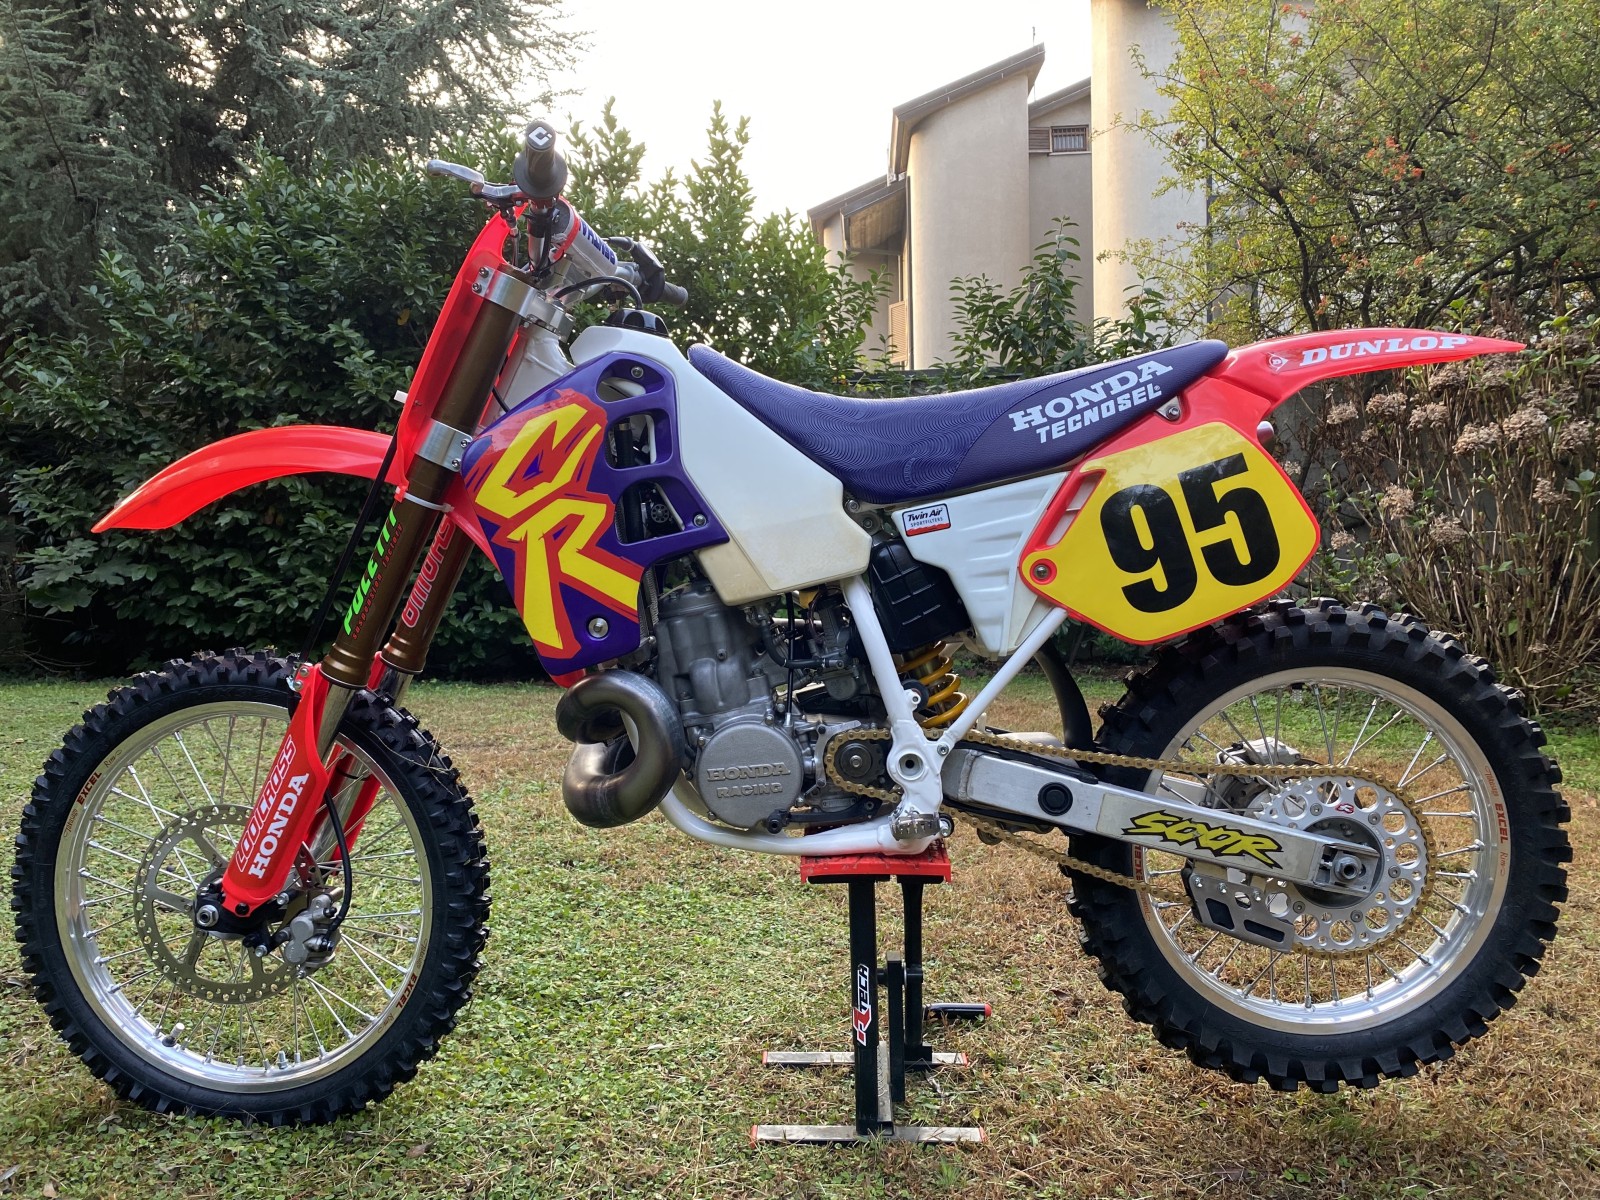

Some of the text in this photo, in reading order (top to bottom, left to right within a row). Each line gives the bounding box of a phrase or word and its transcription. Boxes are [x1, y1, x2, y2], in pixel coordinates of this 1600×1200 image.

[1299, 336, 1468, 366] DUNLOP
[1008, 360, 1173, 432] HONDA
[1035, 384, 1162, 444] TECNOSEL
[474, 402, 641, 650] CR
[907, 508, 943, 522] Twin Air
[1099, 452, 1281, 614] 95
[76, 771, 102, 806] EXCEL
[706, 761, 792, 782] HONDA
[716, 782, 784, 799] RACING
[248, 772, 310, 879] HONDA
[1494, 803, 1508, 844] EXCEL
[396, 973, 418, 1009] EXCEL
